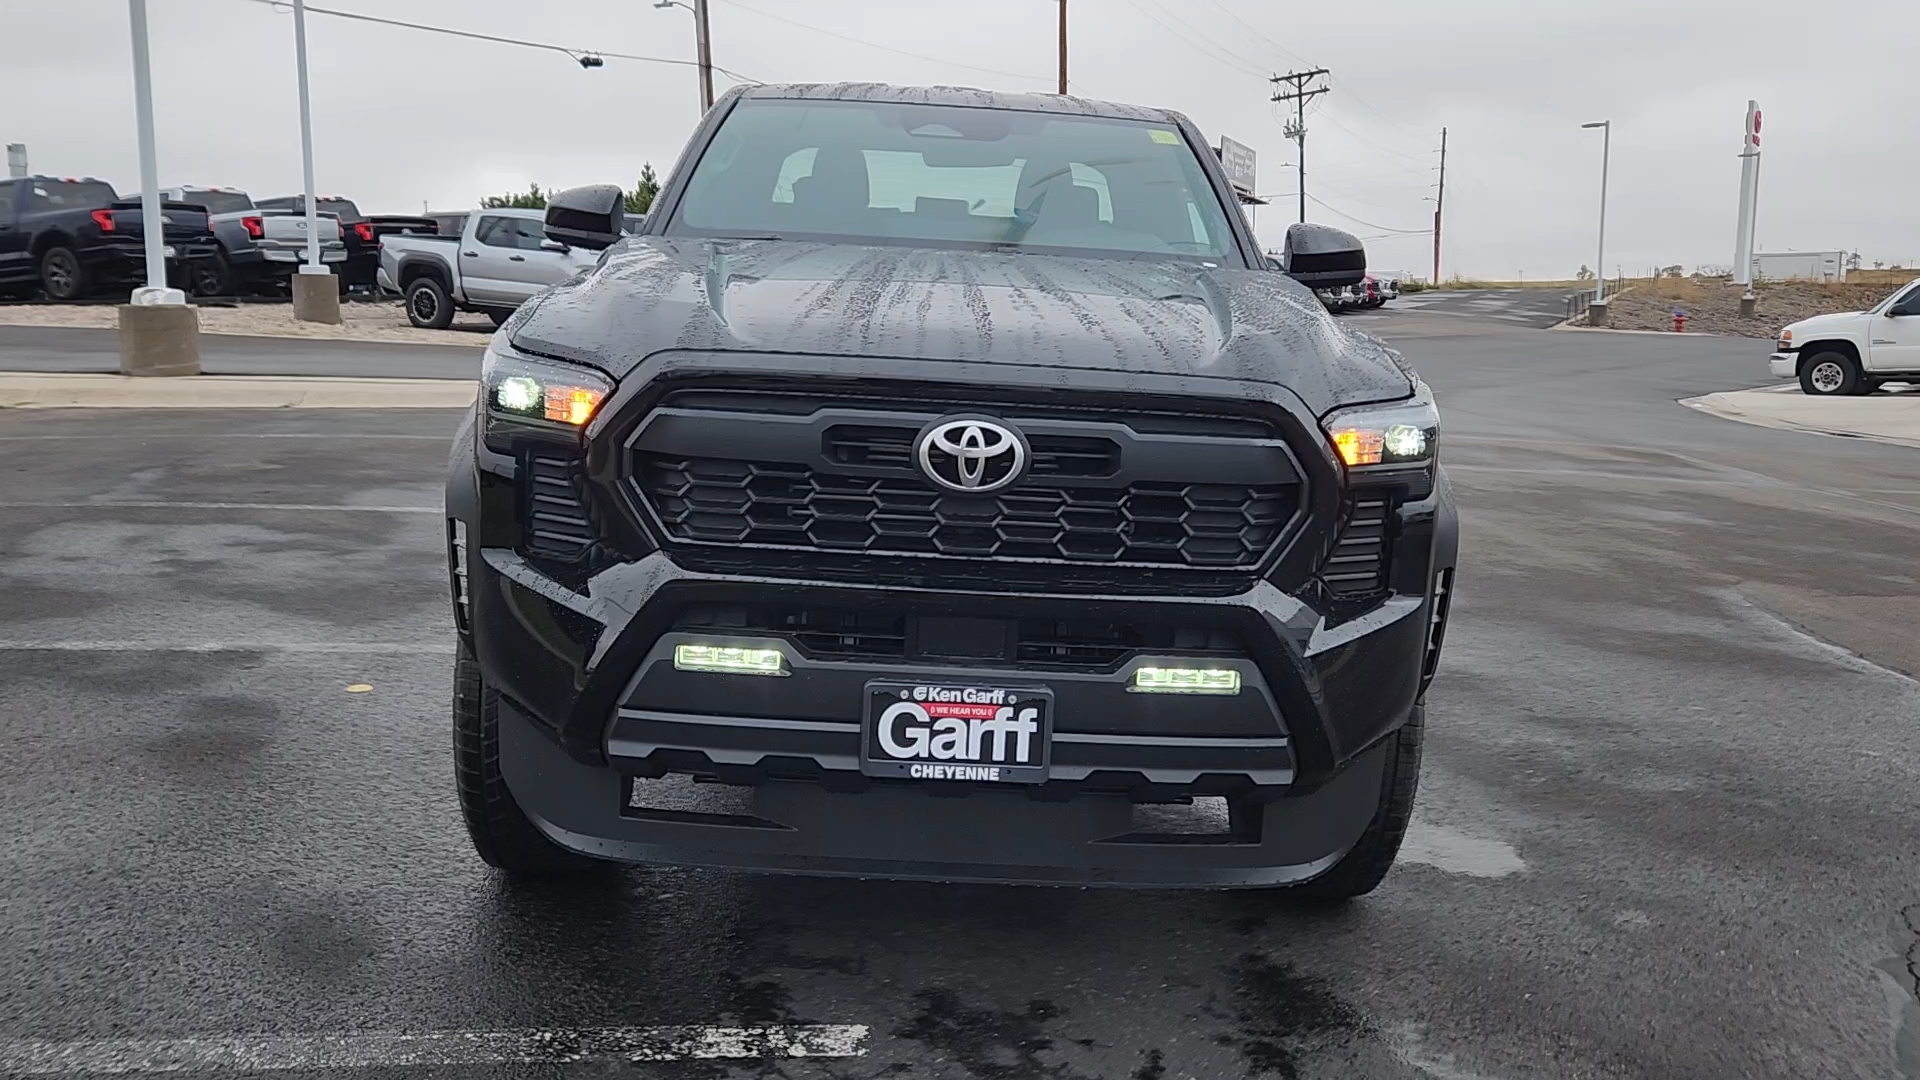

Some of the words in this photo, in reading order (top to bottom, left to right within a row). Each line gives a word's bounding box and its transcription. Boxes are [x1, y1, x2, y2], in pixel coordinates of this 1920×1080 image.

[928, 688, 962, 703] Ken
[963, 689, 1005, 705] Garff
[936, 706, 949, 714] WE
[949, 707, 970, 716] HEAR
[971, 708, 987, 717] YOU
[877, 702, 1038, 762] Garff
[910, 764, 1000, 781] CHEYENNE
